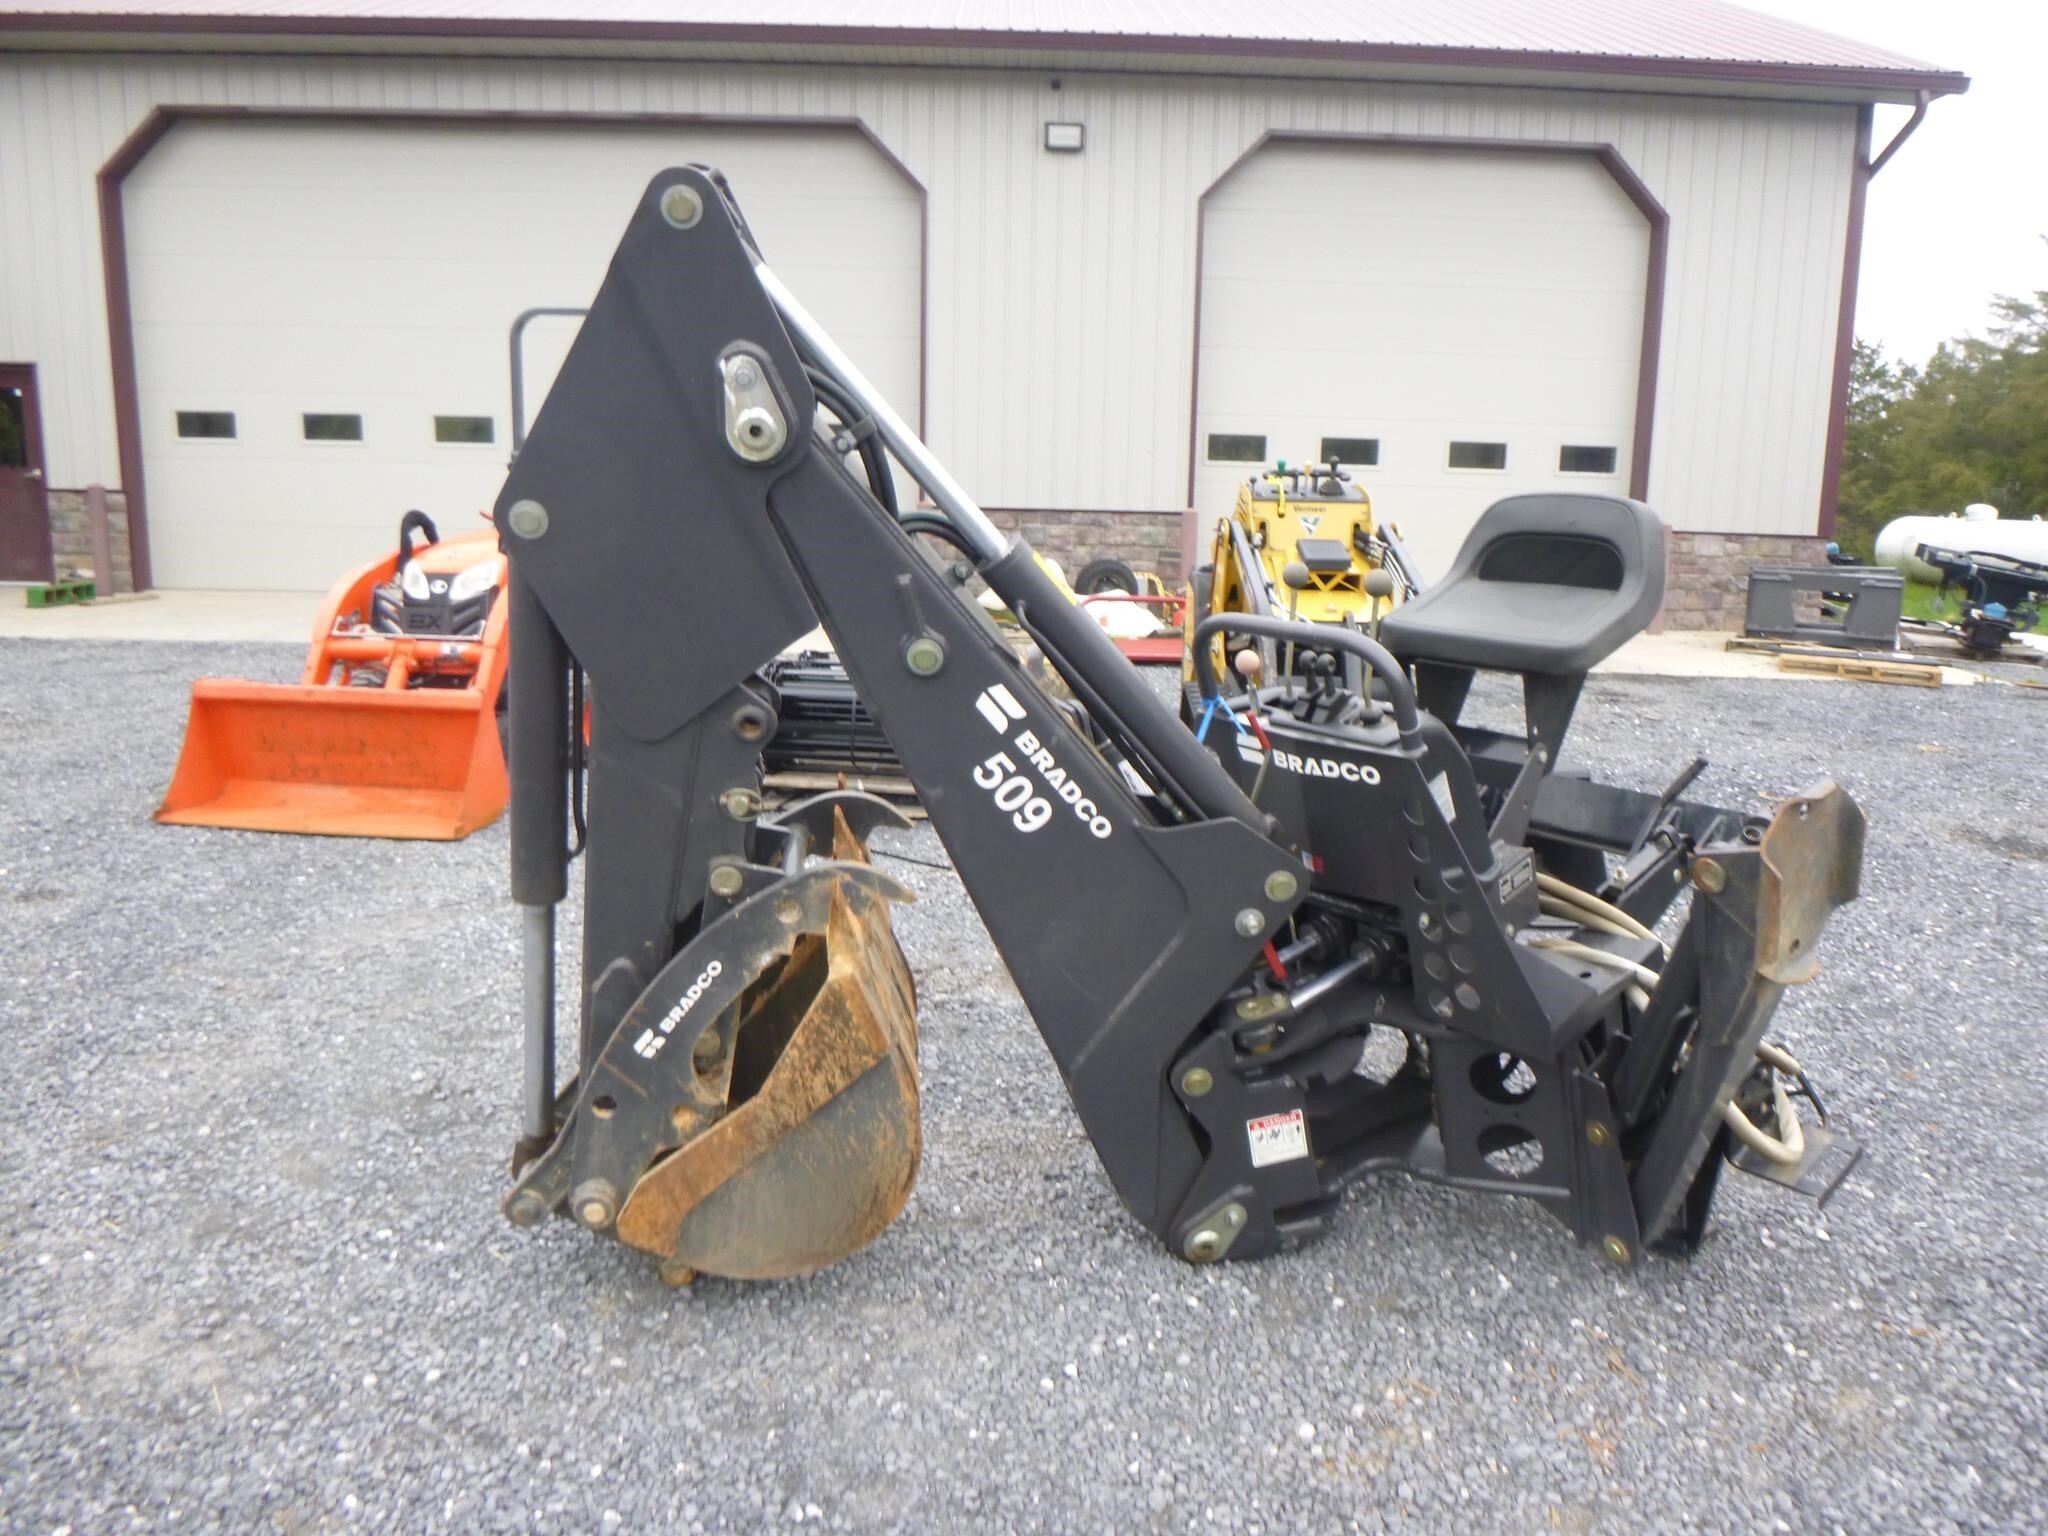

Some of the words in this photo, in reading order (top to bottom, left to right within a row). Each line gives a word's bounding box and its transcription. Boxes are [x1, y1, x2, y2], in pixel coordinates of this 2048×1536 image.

[973, 751, 1053, 833] 509
[1014, 729, 1112, 839] BRADCO
[1272, 749, 1381, 786] BRADCO
[659, 960, 722, 1034] BRADCO
